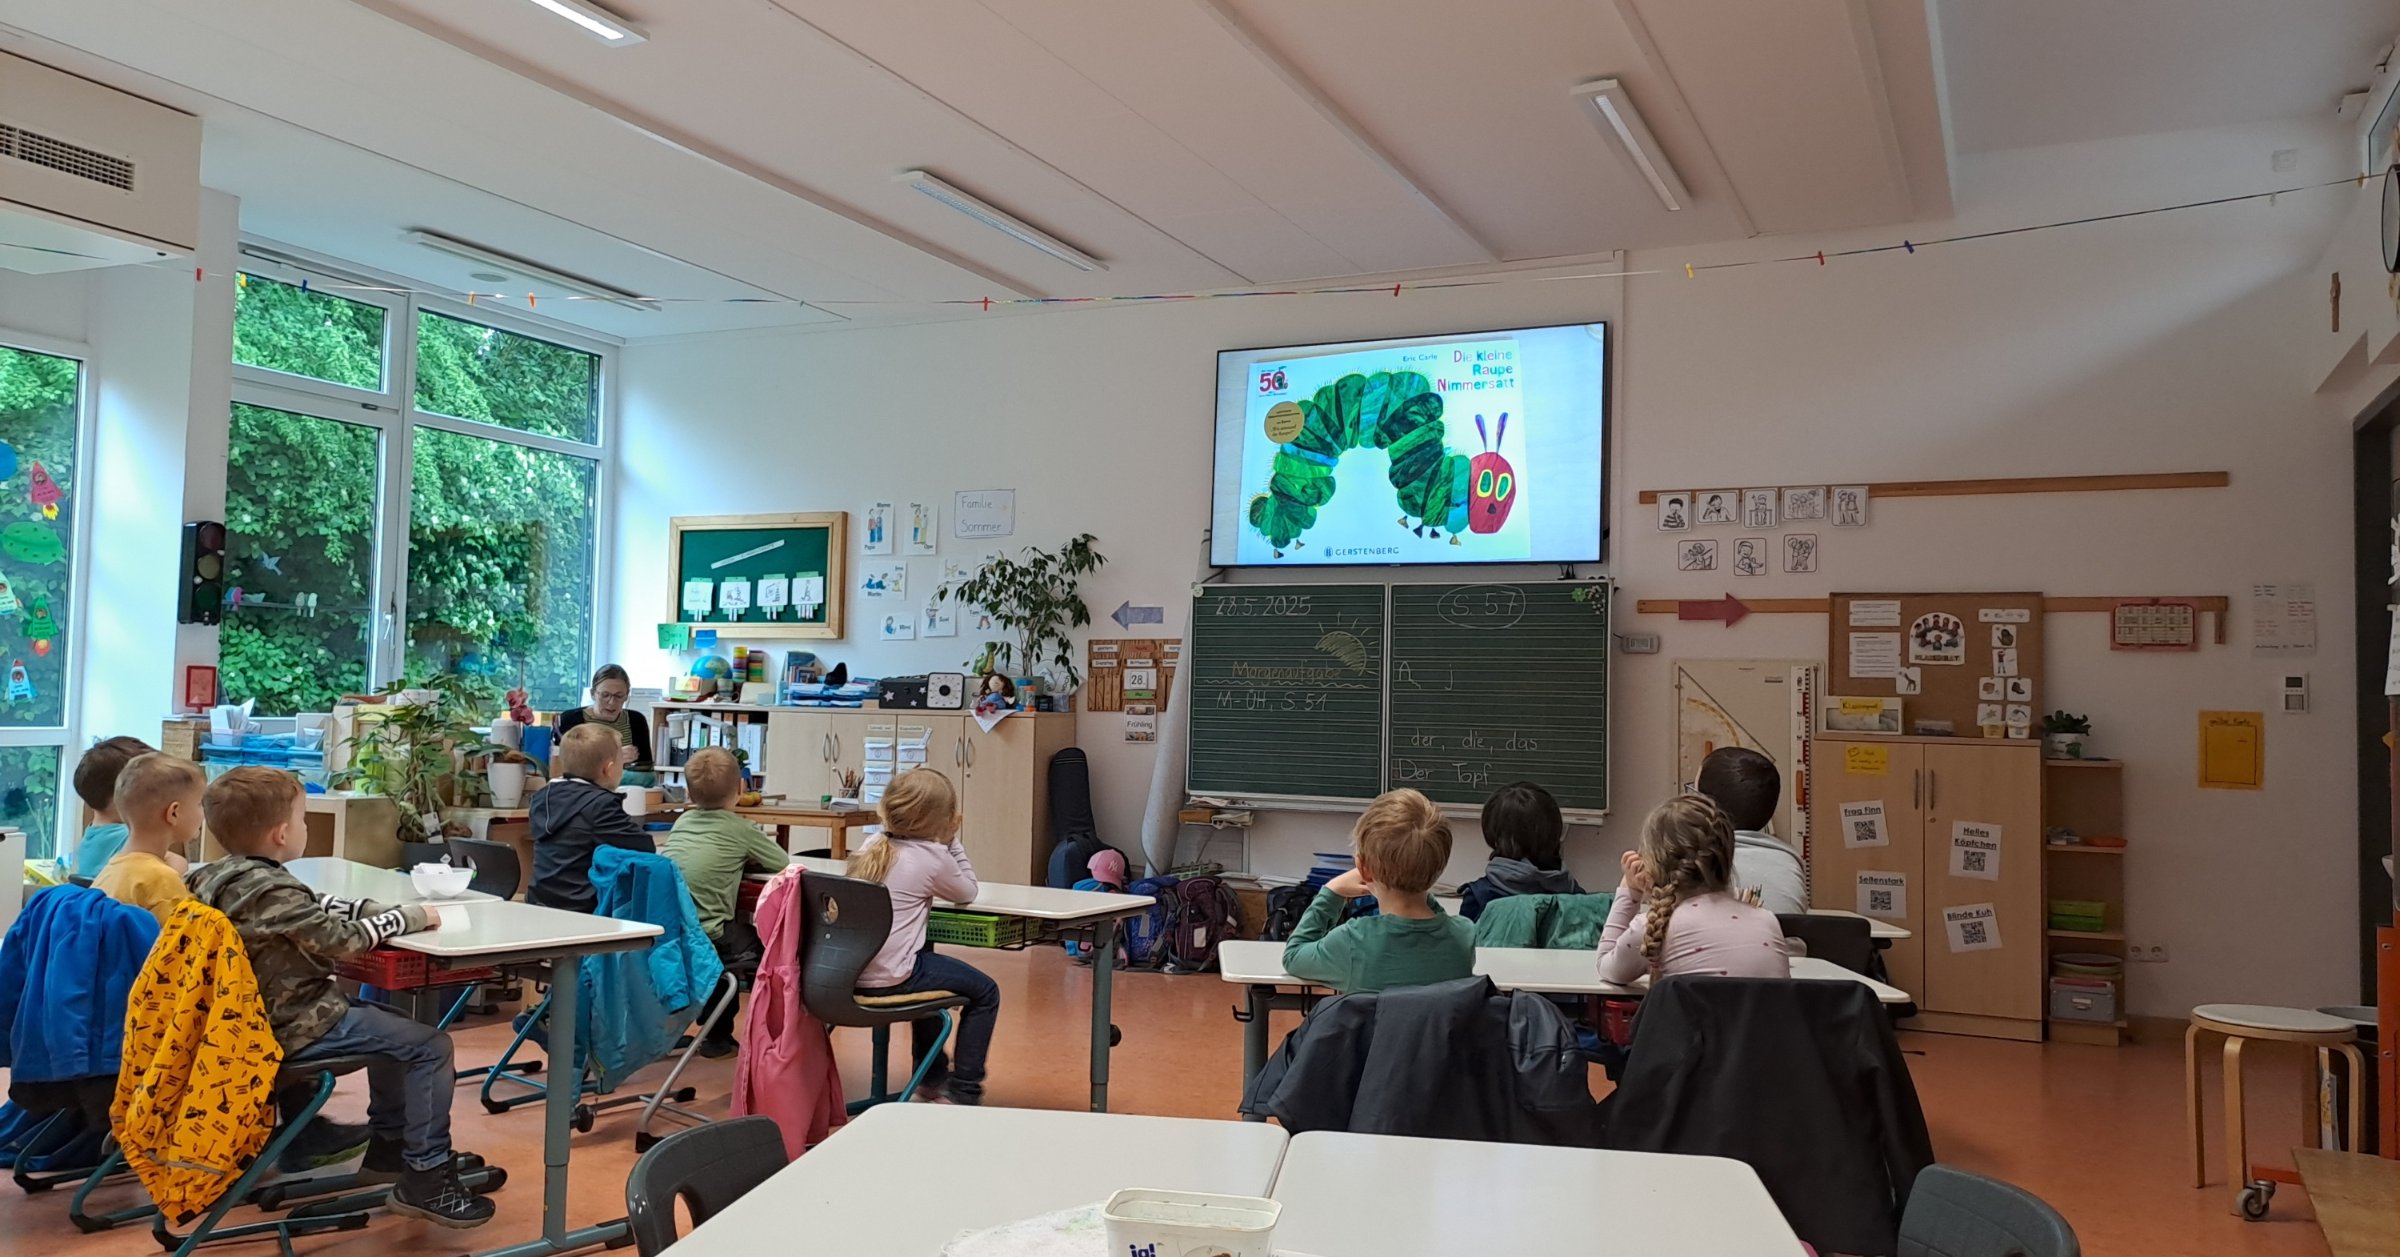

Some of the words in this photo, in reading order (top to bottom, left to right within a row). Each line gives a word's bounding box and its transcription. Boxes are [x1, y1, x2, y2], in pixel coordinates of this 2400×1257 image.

[1418, 353, 1437, 361] Carle
[1454, 350, 1472, 363] Die
[1476, 350, 1512, 362] kleine
[1473, 363, 1513, 377] Raupe
[1437, 378, 1514, 392] Nimmersatt
[961, 496, 992, 509] Familie
[960, 519, 1001, 533] Sommer
[1335, 546, 1399, 556] GERSTENBERG
[1485, 591, 1518, 615] 57
[1304, 692, 1328, 712] 51
[1127, 720, 1153, 729] Frühling
[1505, 730, 1539, 751] das
[1398, 758, 1434, 779] Der
[1451, 762, 1493, 789] Topf
[1864, 806, 1882, 814] Finn
[1963, 827, 1989, 838] Helles
[1954, 838, 1997, 850] Köpfchen
[1947, 911, 1974, 921] Blinde
[1975, 908, 1992, 918] Kuh
